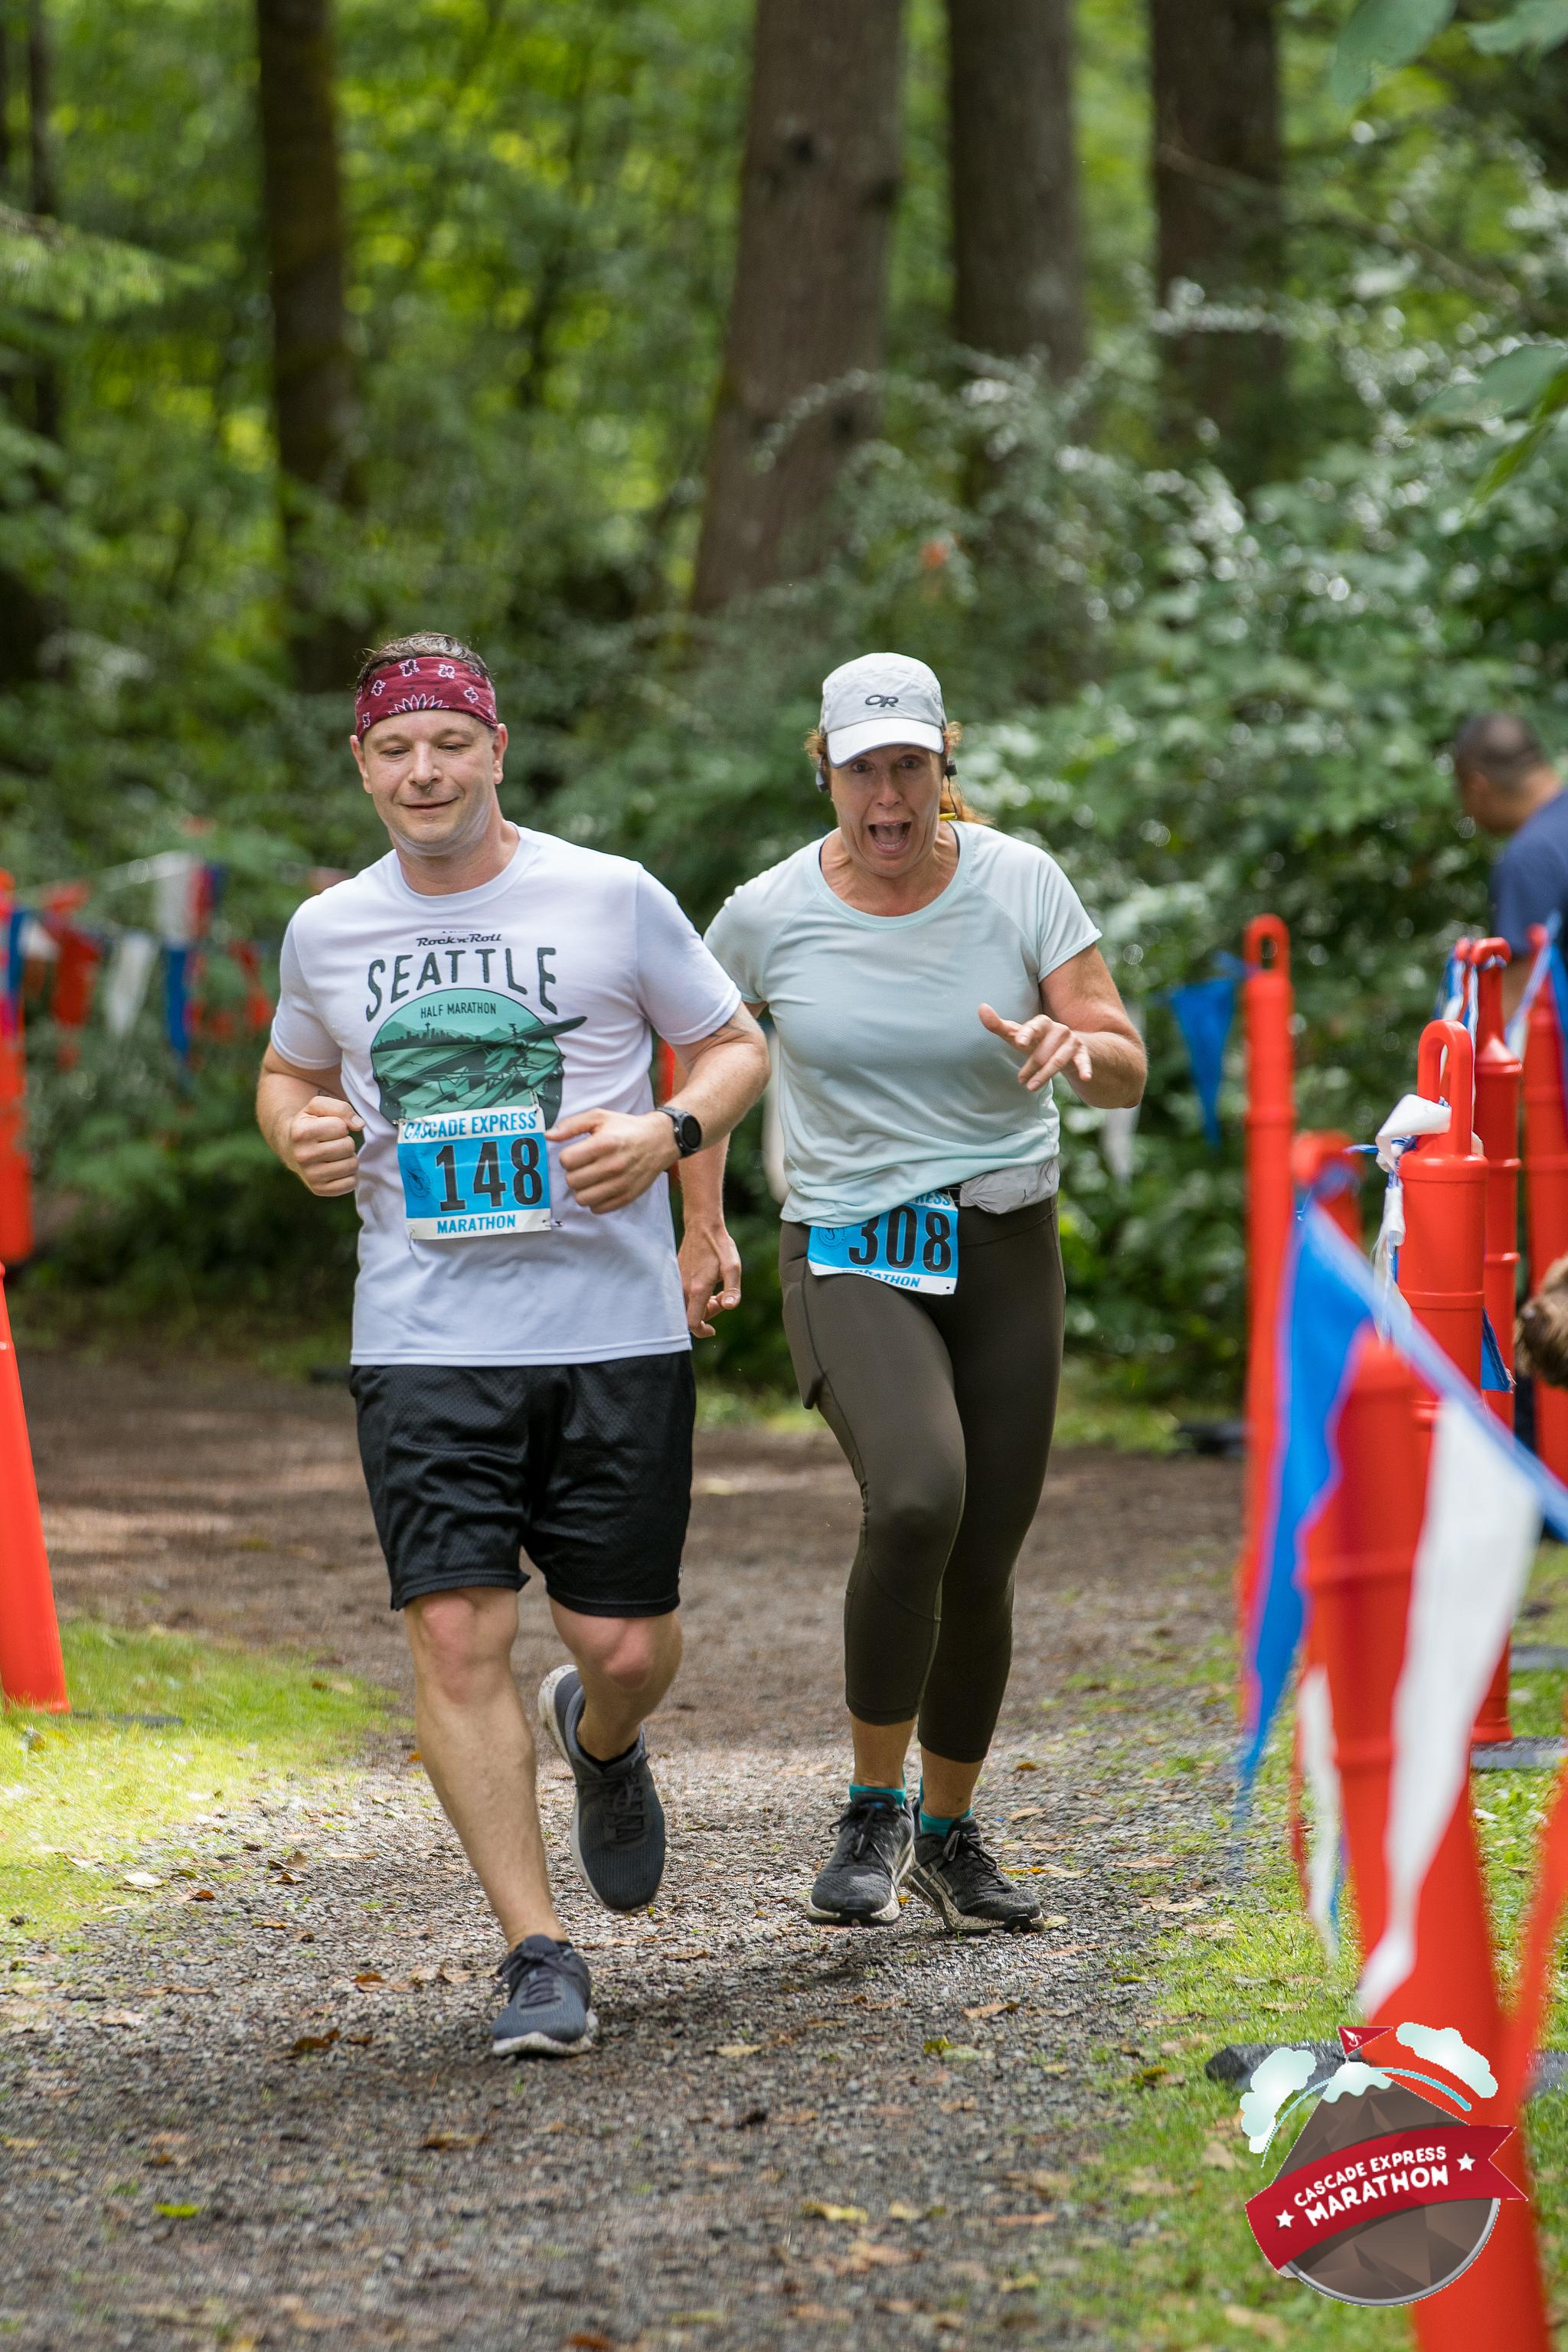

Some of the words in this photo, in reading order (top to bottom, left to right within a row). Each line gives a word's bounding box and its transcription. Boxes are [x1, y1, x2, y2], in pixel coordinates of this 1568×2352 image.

[865, 694, 899, 707] OR
[366, 947, 558, 1022] SEATTLE
[420, 1005, 444, 1018] HALF
[447, 1002, 497, 1015] MARATHON
[403, 1118, 466, 1140] CASCADE
[472, 1112, 537, 1135] EXPRESS
[435, 1137, 543, 1212] 148
[437, 1214, 516, 1234] MARATHON
[848, 1204, 952, 1273] 308
